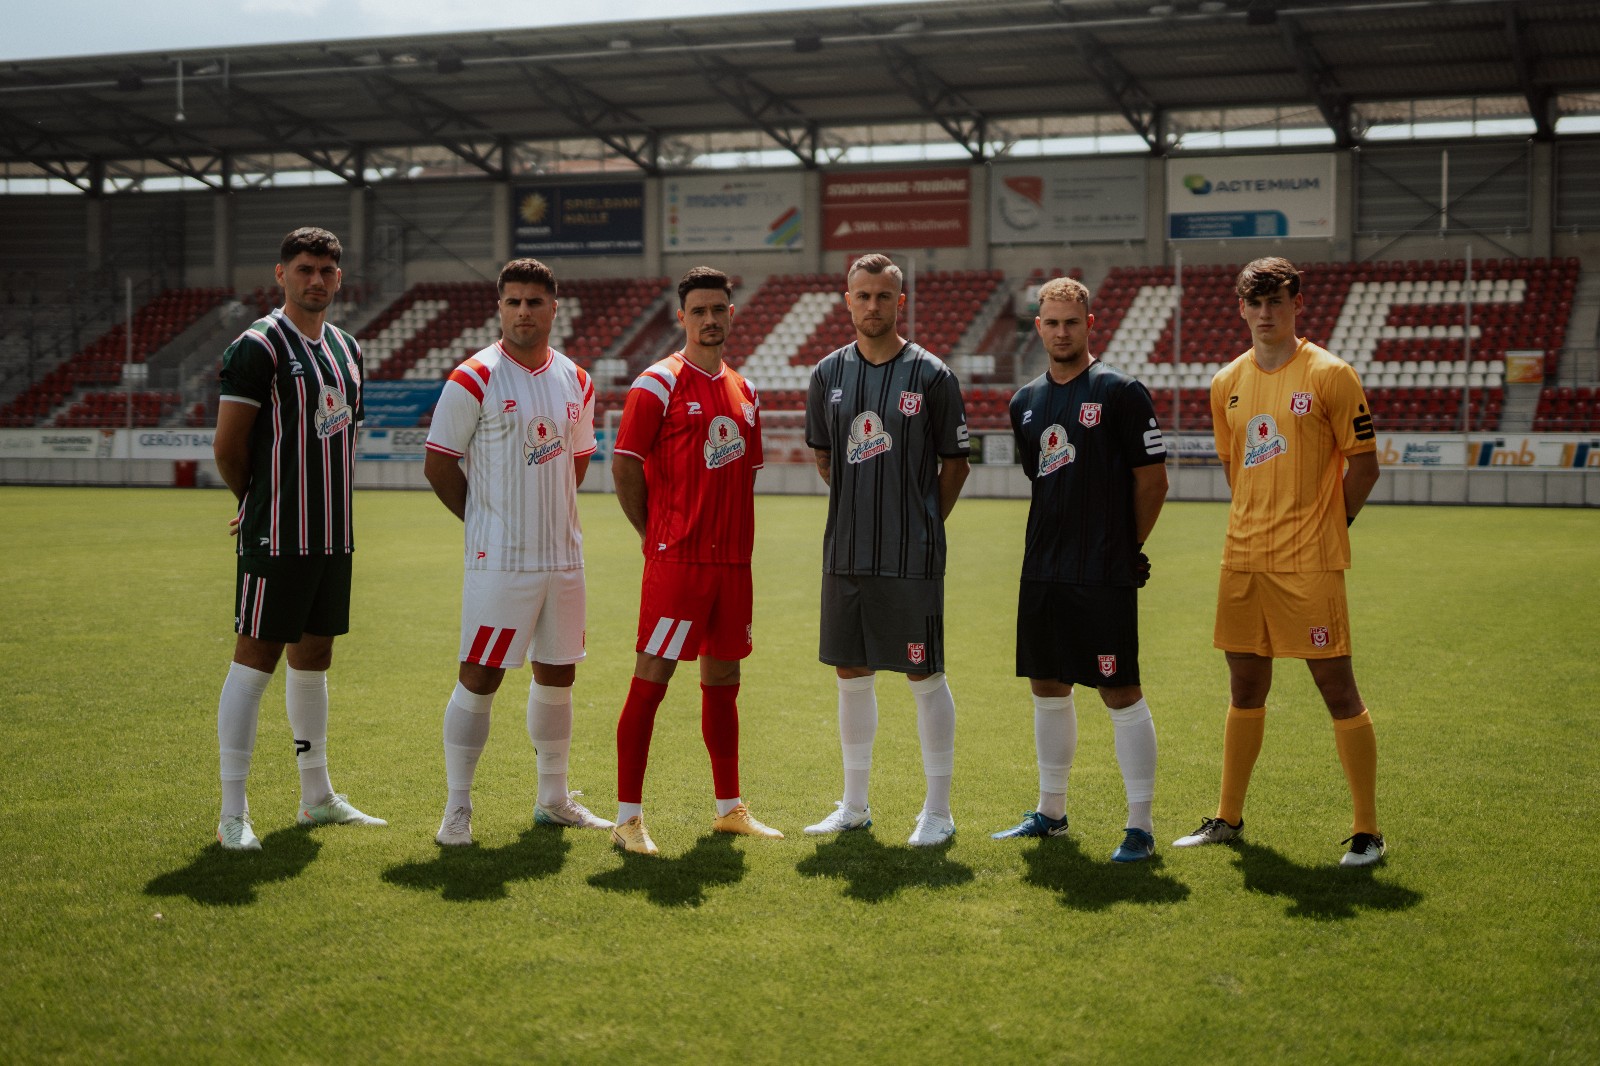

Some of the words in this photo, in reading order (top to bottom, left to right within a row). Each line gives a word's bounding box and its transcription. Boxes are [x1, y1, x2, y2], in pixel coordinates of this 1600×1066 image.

[1212, 177, 1320, 192] ACTEMIUM
[1293, 392, 1312, 400] HFC
[1083, 403, 1100, 411] HFC
[527, 439, 561, 466] Halloren
[709, 441, 741, 467] Halloren
[1244, 439, 1280, 466] Halloren
